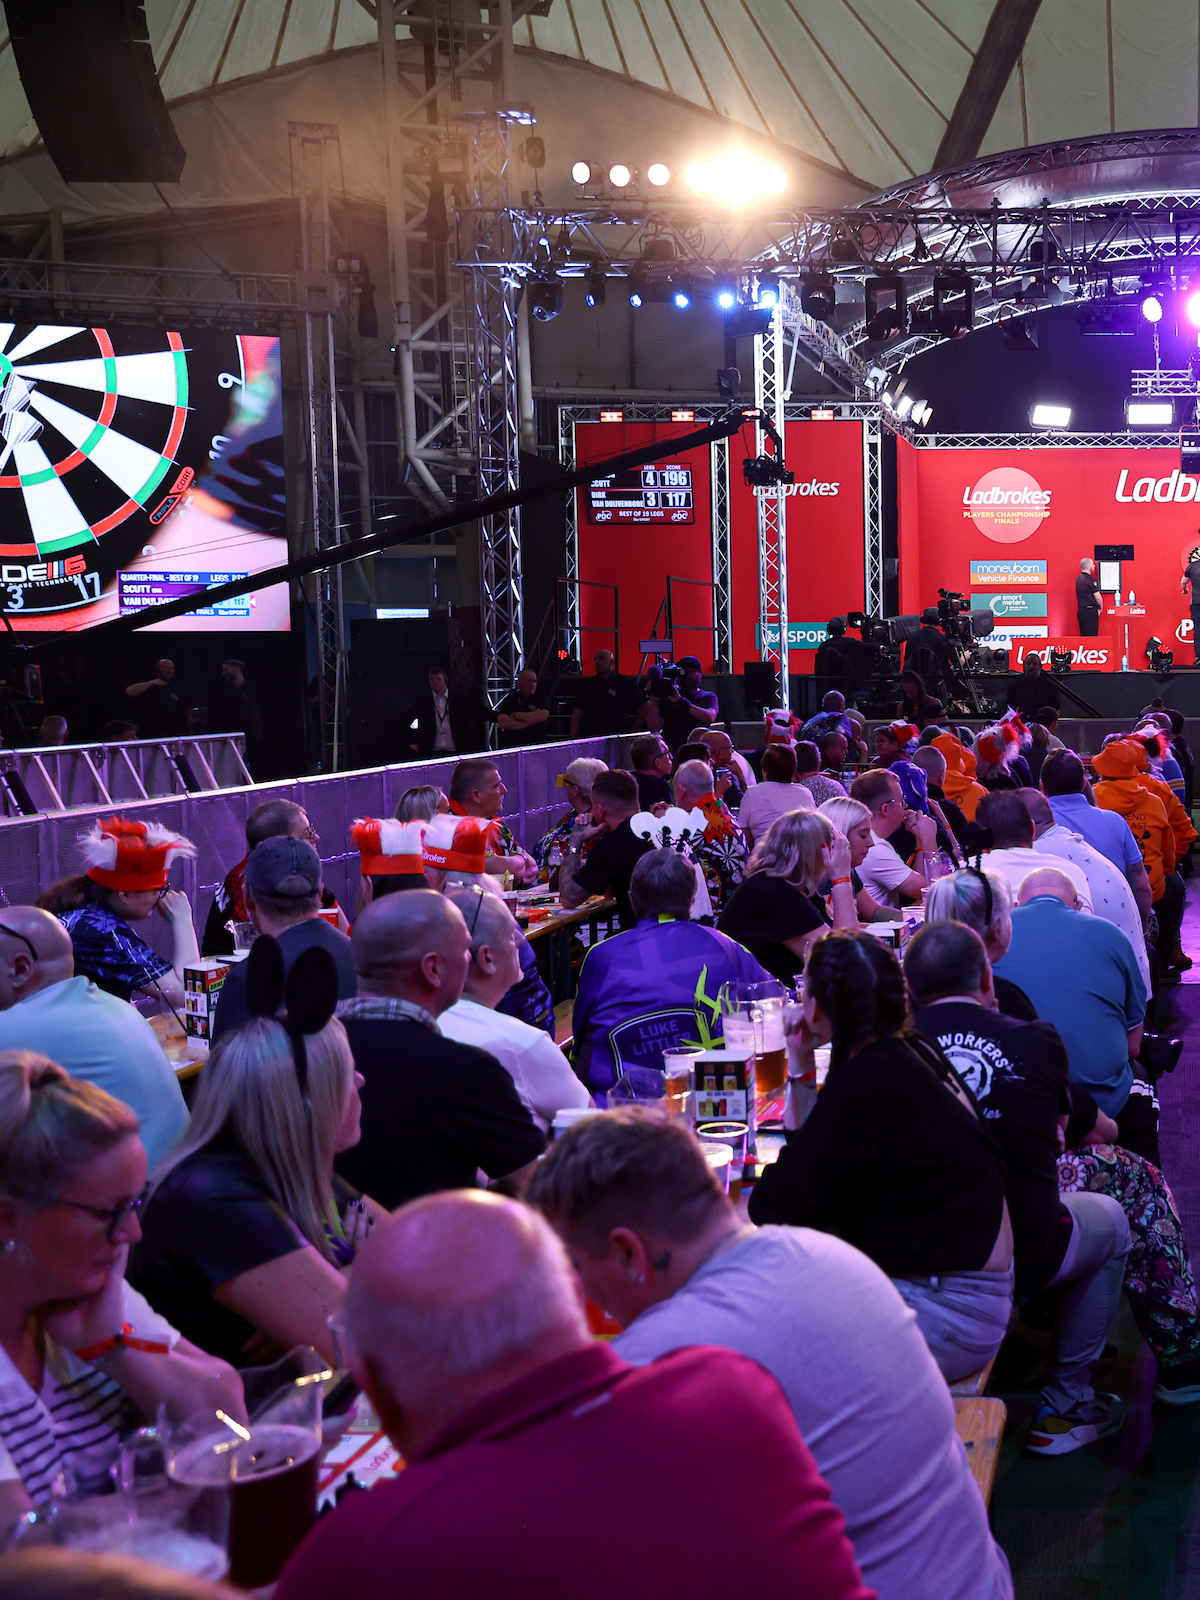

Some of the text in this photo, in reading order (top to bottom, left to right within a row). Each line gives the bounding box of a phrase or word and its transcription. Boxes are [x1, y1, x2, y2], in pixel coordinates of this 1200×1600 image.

[177, 468, 192, 491] CORE
[645, 471, 655, 486] 4
[662, 471, 687, 486] 196
[591, 491, 686, 507] DIRK 3 117
[962, 486, 1053, 505] Ladbrokes
[592, 500, 604, 508] VAN
[120, 573, 166, 582] QUARTER-FINAL
[169, 573, 184, 582] BEST
[184, 573, 193, 582] OF
[193, 573, 199, 582] 19
[210, 574, 229, 582] LEGS
[73, 571, 101, 601] 17
[123, 584, 152, 593] SCUTT
[6, 584, 25, 610] 3
[123, 597, 141, 606] VAN
[234, 598, 245, 606] 117
[639, 1019, 679, 1039] LUKE
[632, 1032, 692, 1056] LITTLER
[937, 1032, 1009, 1068] WORKERS
